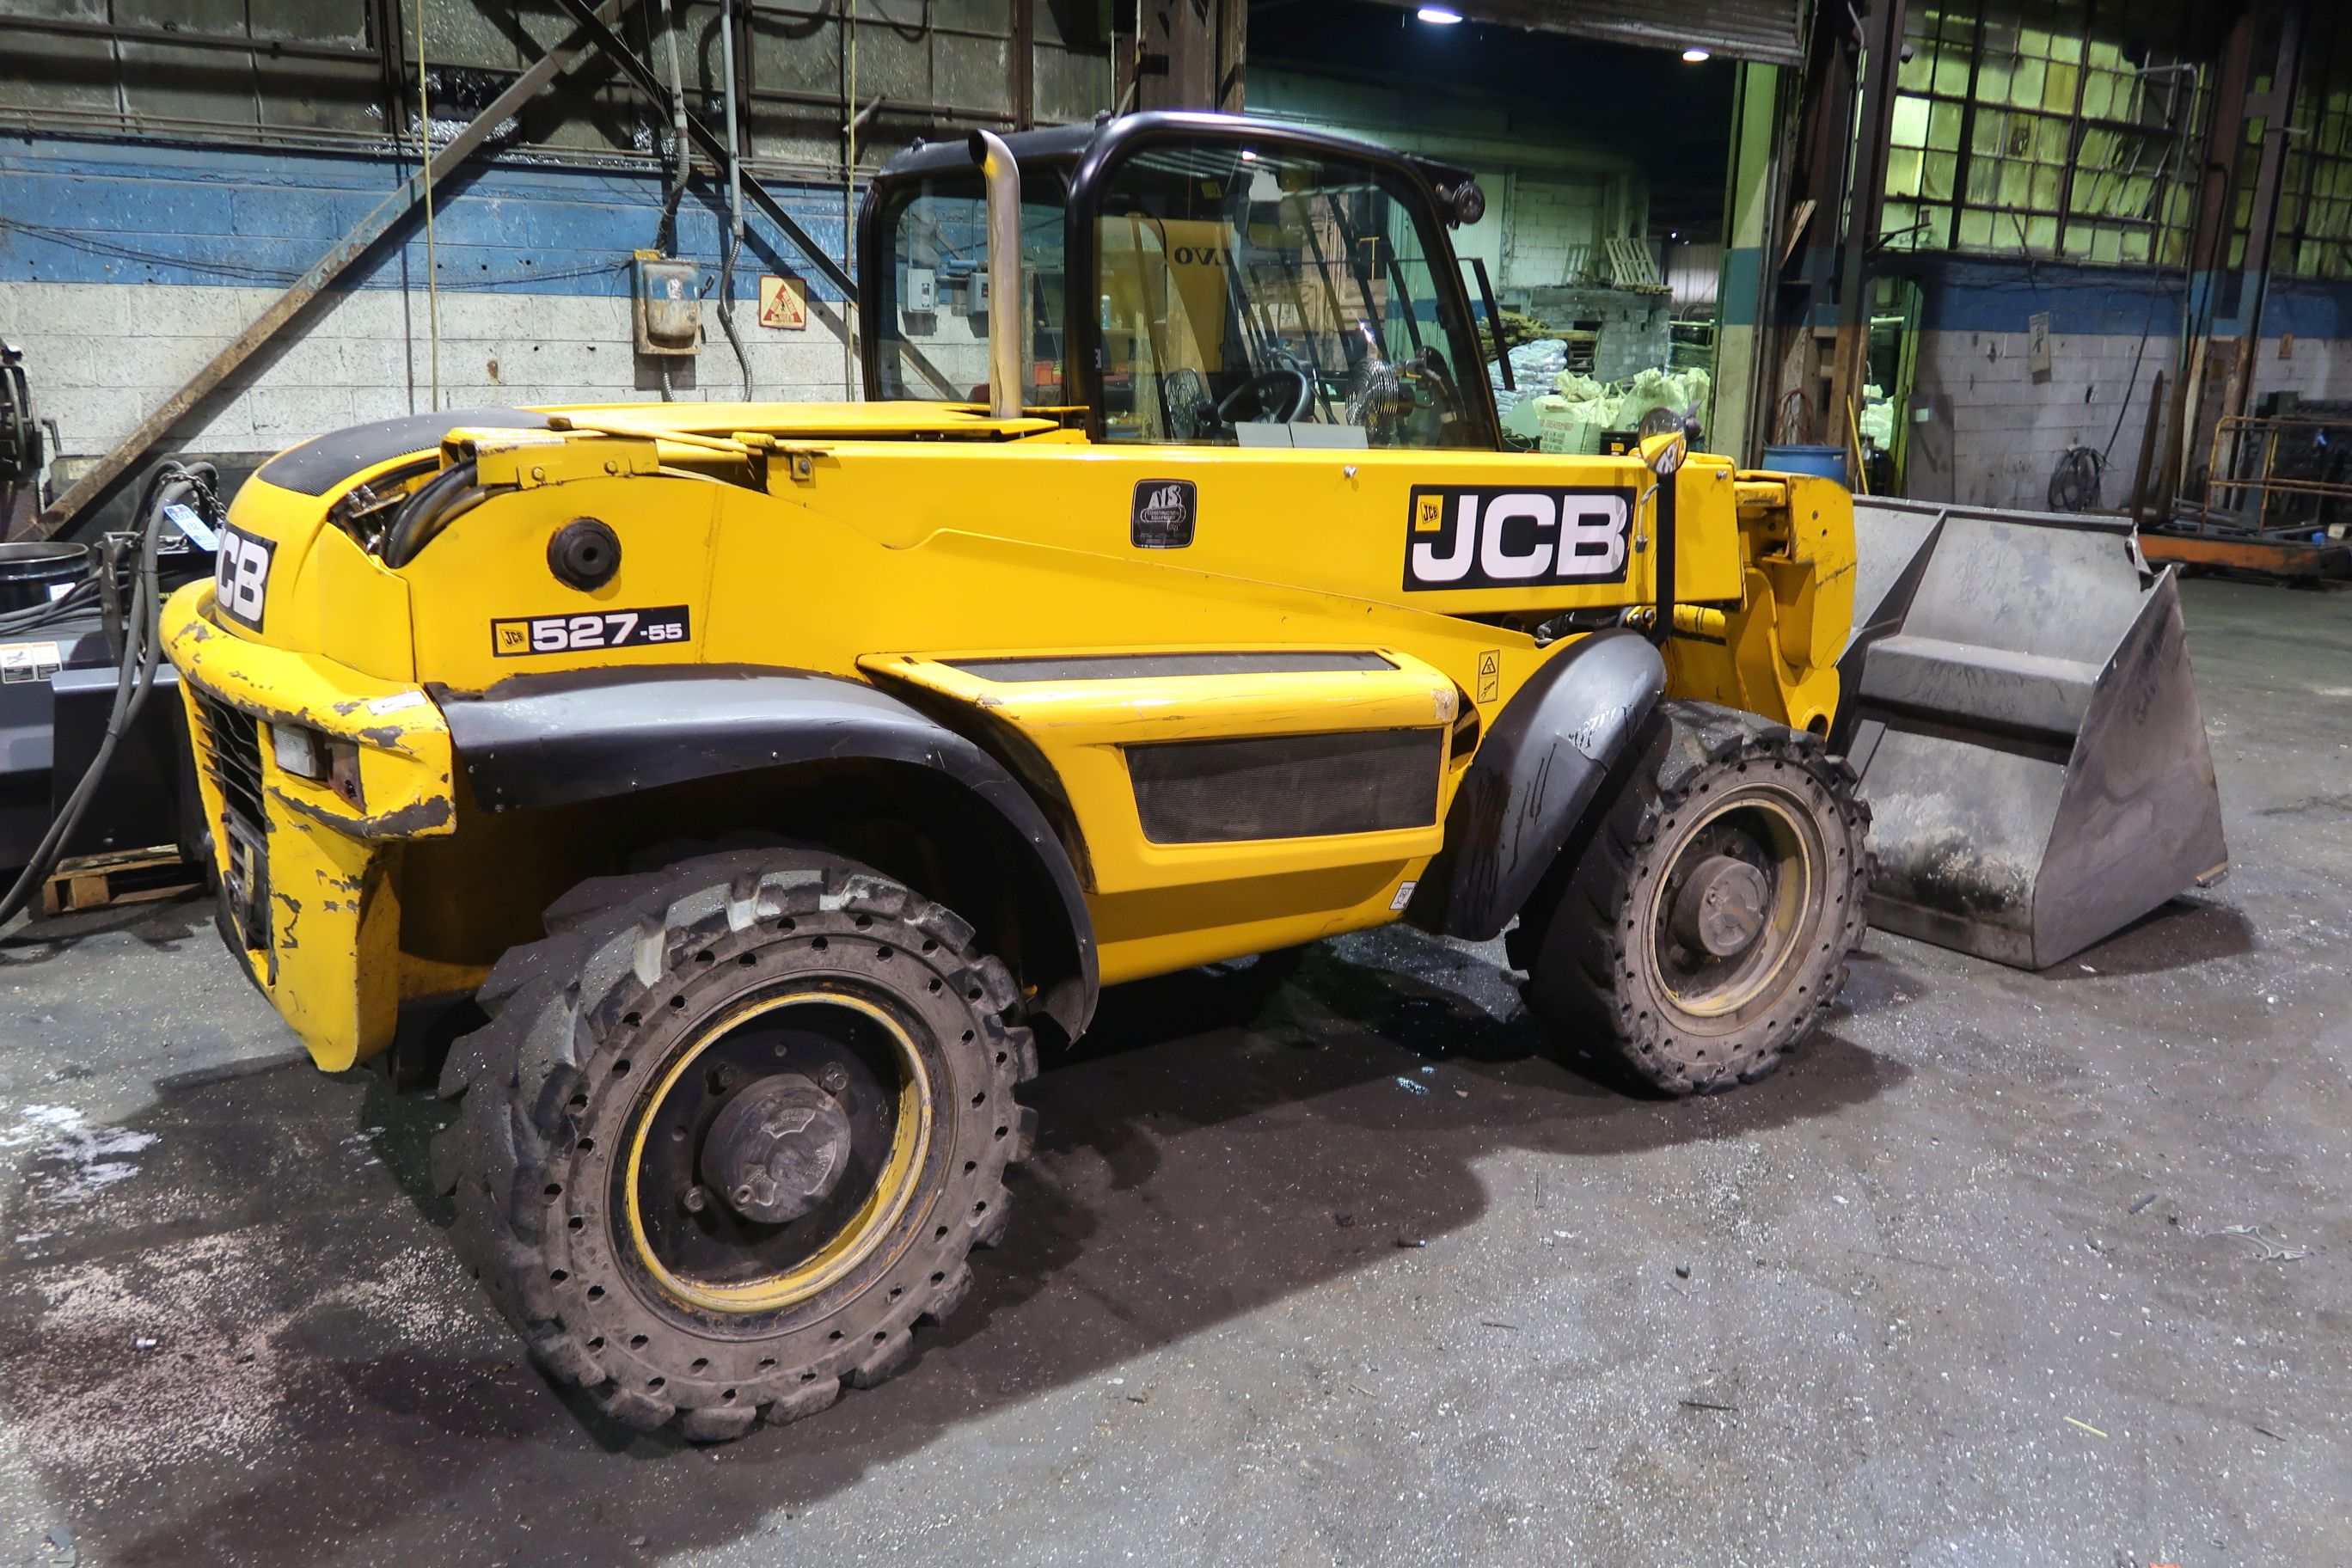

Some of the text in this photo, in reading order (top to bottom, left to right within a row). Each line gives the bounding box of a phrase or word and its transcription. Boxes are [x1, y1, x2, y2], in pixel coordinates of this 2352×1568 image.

[1412, 494, 1628, 582] JCB
[1422, 505, 1438, 521] JCB
[217, 530, 269, 622] CB
[505, 629, 524, 646] JCB
